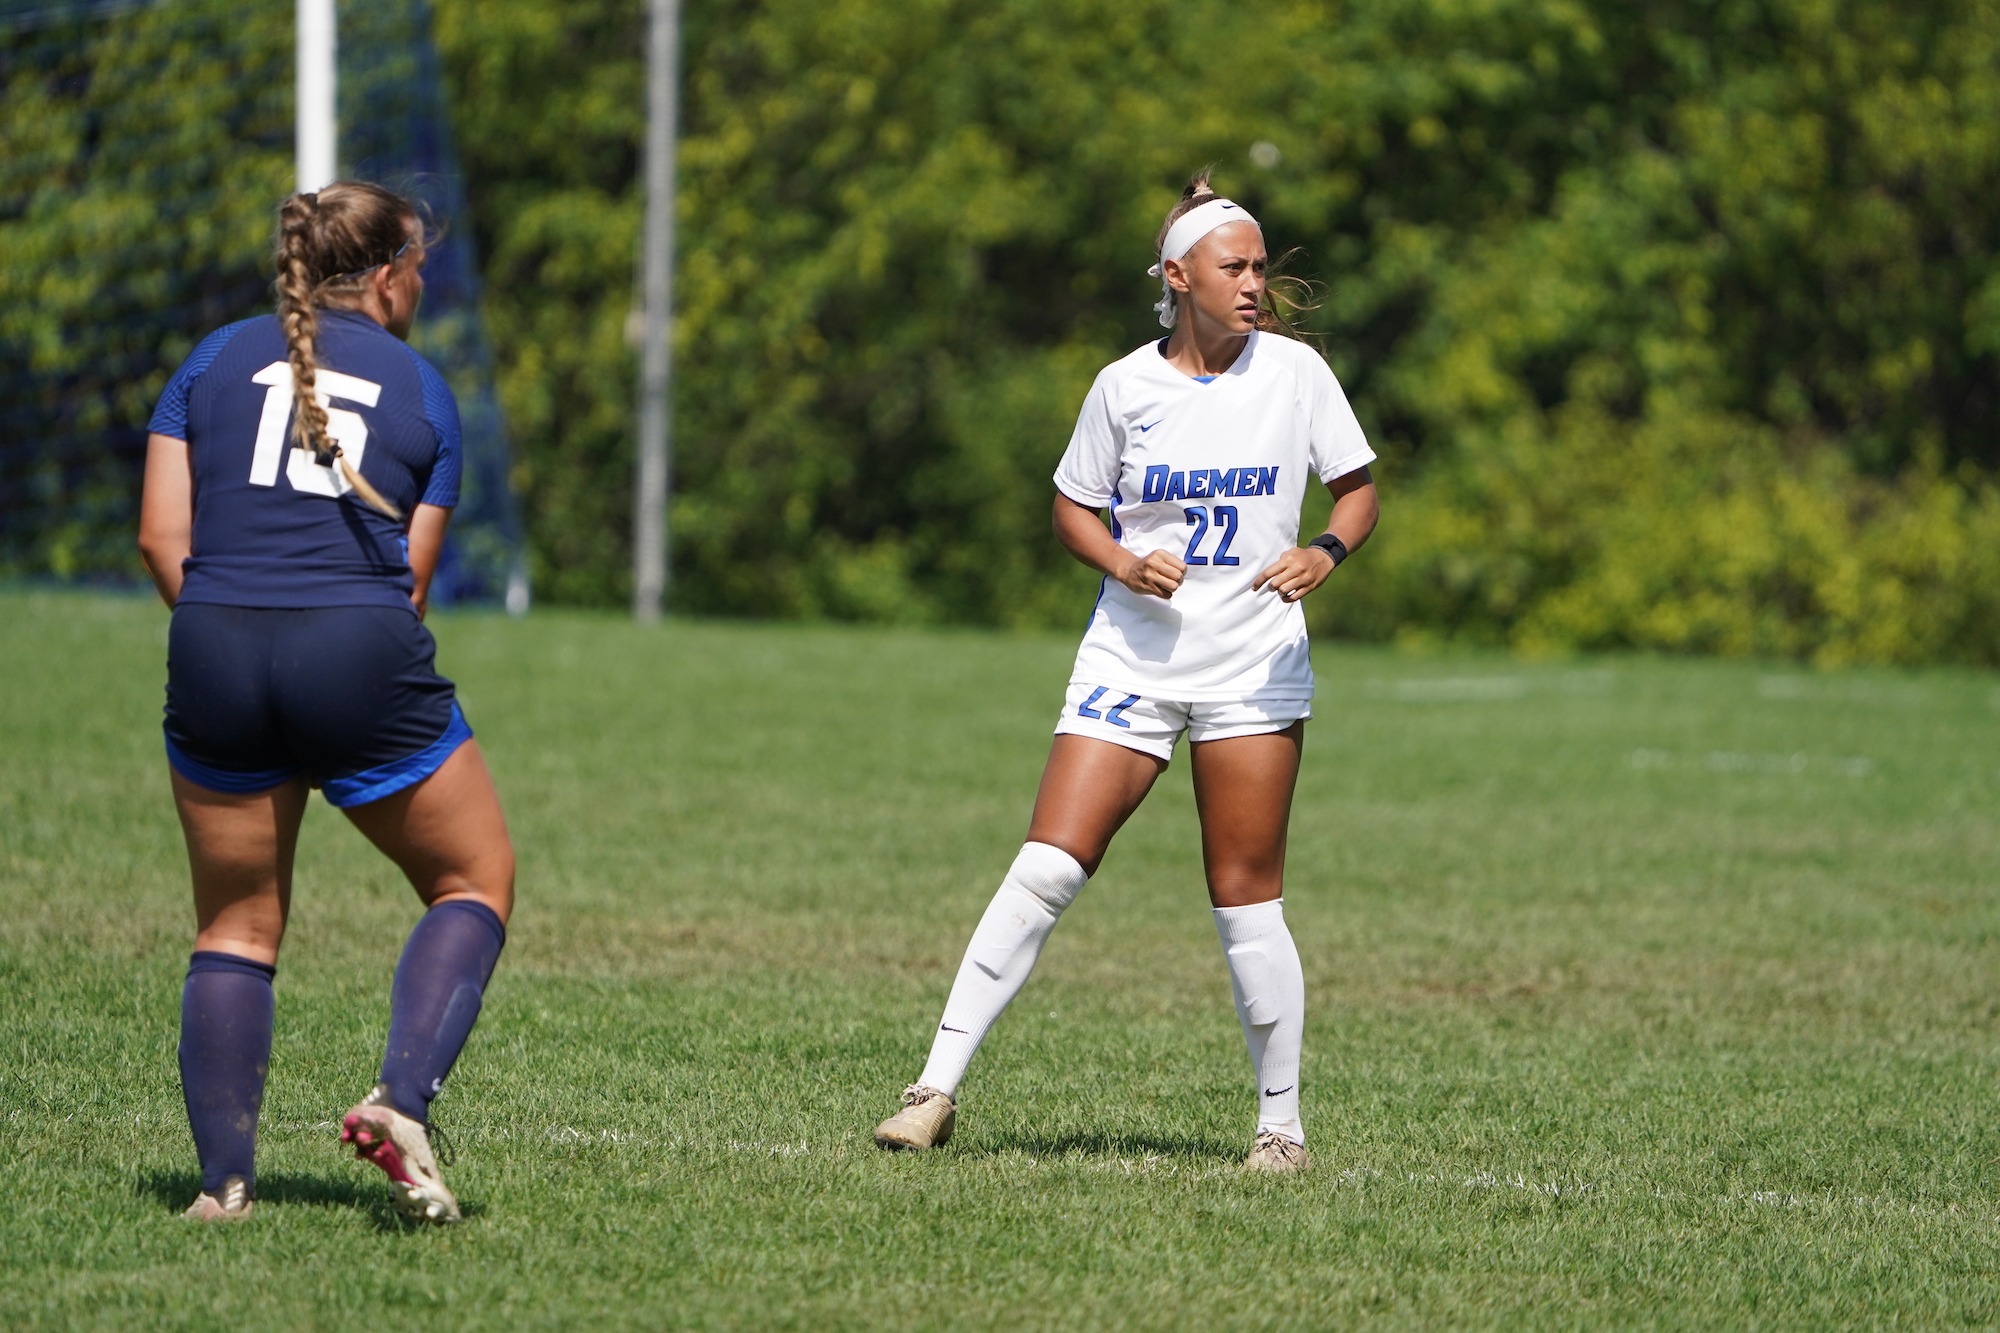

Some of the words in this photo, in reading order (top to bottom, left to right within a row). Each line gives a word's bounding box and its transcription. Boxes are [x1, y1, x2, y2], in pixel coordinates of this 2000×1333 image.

[249, 361, 382, 498] 15
[1141, 464, 1279, 503] DAEMEN
[1183, 505, 1239, 566] 22
